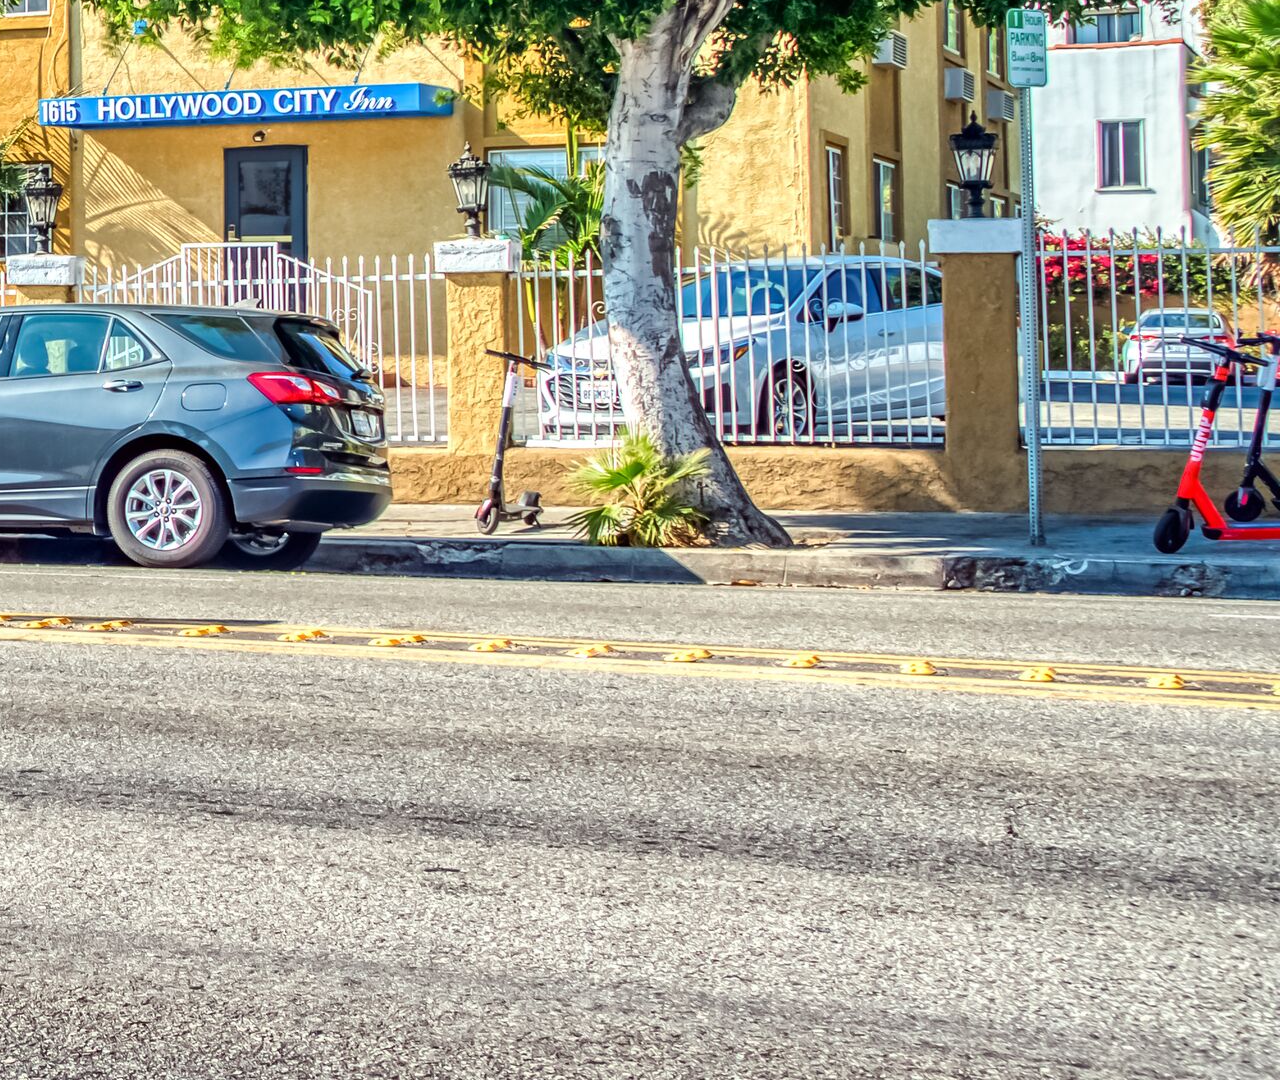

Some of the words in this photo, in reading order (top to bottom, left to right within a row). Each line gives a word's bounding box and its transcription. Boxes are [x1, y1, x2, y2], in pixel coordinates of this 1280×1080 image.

[1010, 32, 1043, 47] PARKING
[41, 100, 77, 123] 1615
[97, 92, 263, 120] HOLLYWOOD
[273, 89, 337, 114] CITY
[343, 86, 394, 112] Inn
